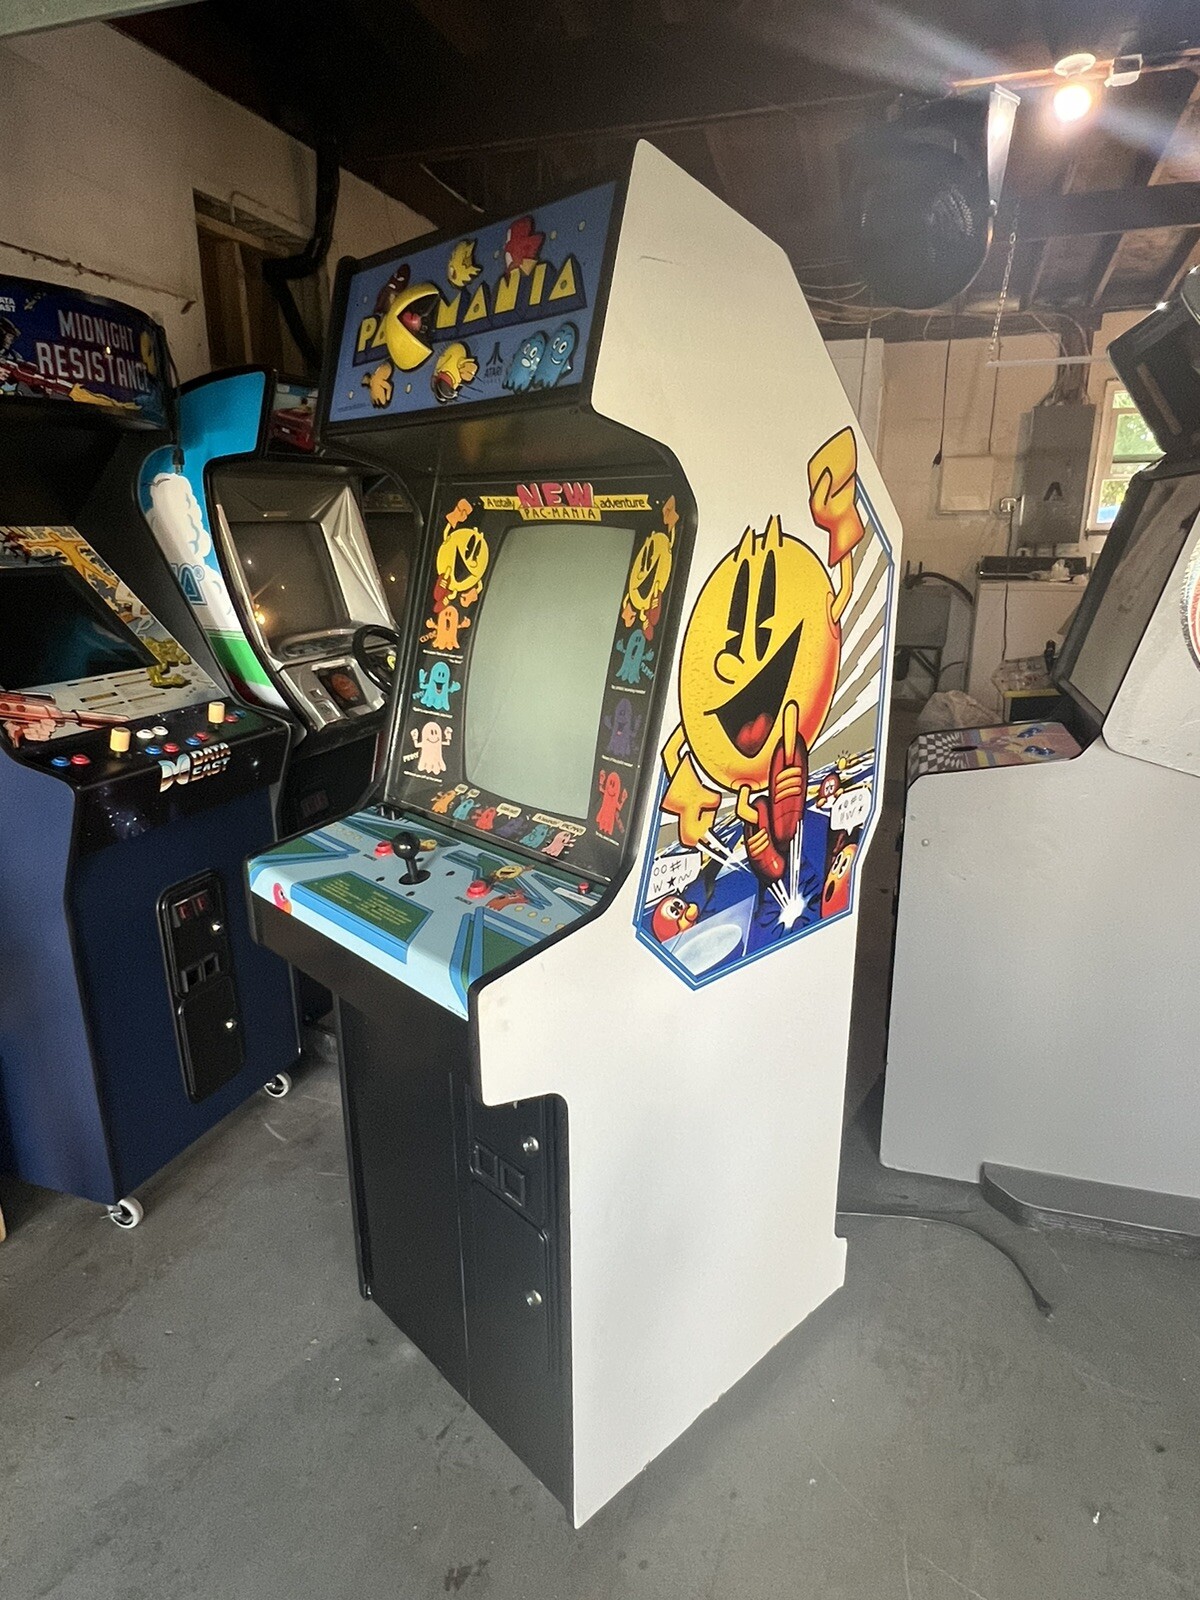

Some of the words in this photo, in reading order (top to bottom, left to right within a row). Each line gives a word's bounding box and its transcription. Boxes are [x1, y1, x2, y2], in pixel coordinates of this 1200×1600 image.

[57, 309, 135, 353] MIDNIGHT
[36, 342, 151, 393] RESISTANCE
[516, 481, 595, 508] NEW
[600, 498, 645, 509] adventure
[190, 742, 232, 766] DATA
[190, 757, 231, 782] EAST
